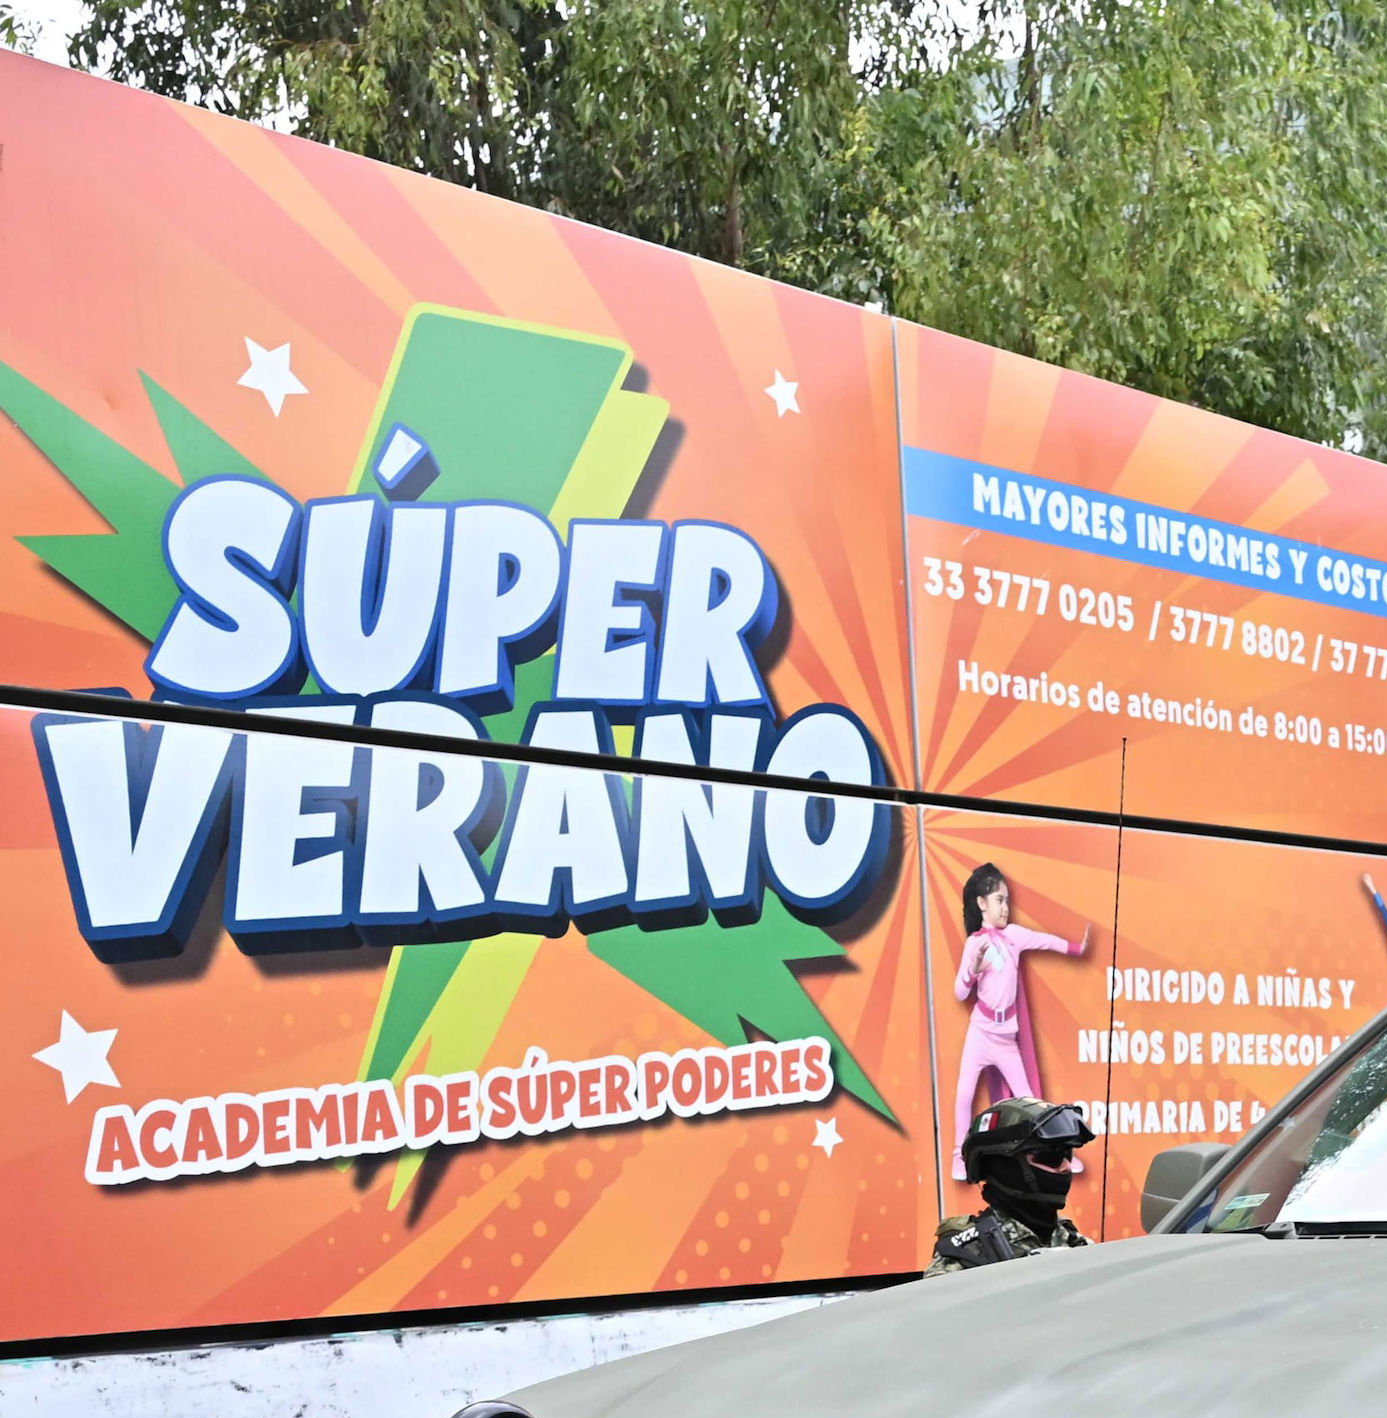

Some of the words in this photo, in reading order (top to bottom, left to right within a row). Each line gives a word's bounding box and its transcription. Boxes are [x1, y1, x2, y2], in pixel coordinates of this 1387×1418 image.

[148, 424, 770, 706] SÚPER
[973, 472, 1128, 545] MAYORES
[1135, 512, 1281, 580] INFORMES
[1288, 549, 1308, 584] Y
[923, 556, 965, 600] 33
[973, 566, 1050, 616] 3777
[1058, 583, 1135, 632] 0205
[1148, 600, 1162, 641] /
[1169, 605, 1235, 650] 3777
[1241, 620, 1306, 665] 8802
[1311, 634, 1324, 672] /
[1330, 638, 1358, 674] 37
[958, 659, 1081, 709] Horarios
[1087, 681, 1121, 715] de
[1127, 692, 1233, 733] atención
[1238, 706, 1268, 739] de
[1274, 711, 1322, 746] 8:00
[1327, 726, 1340, 749] a
[40, 700, 878, 932] VERANO
[1078, 1020, 1166, 1065] NIÑOS
[1173, 1030, 1203, 1065] DE
[1106, 966, 1225, 1006] DIRIGIDO
[1233, 973, 1251, 1006] A
[1257, 967, 1332, 1010] NIÑAS
[1337, 979, 1356, 1010] Y
[96, 1088, 399, 1174] ACADEMIA
[413, 1079, 472, 1138] DE
[487, 1055, 633, 1129] SÚPER
[644, 1045, 828, 1110] PODERES
[1213, 1100, 1243, 1133] DE
